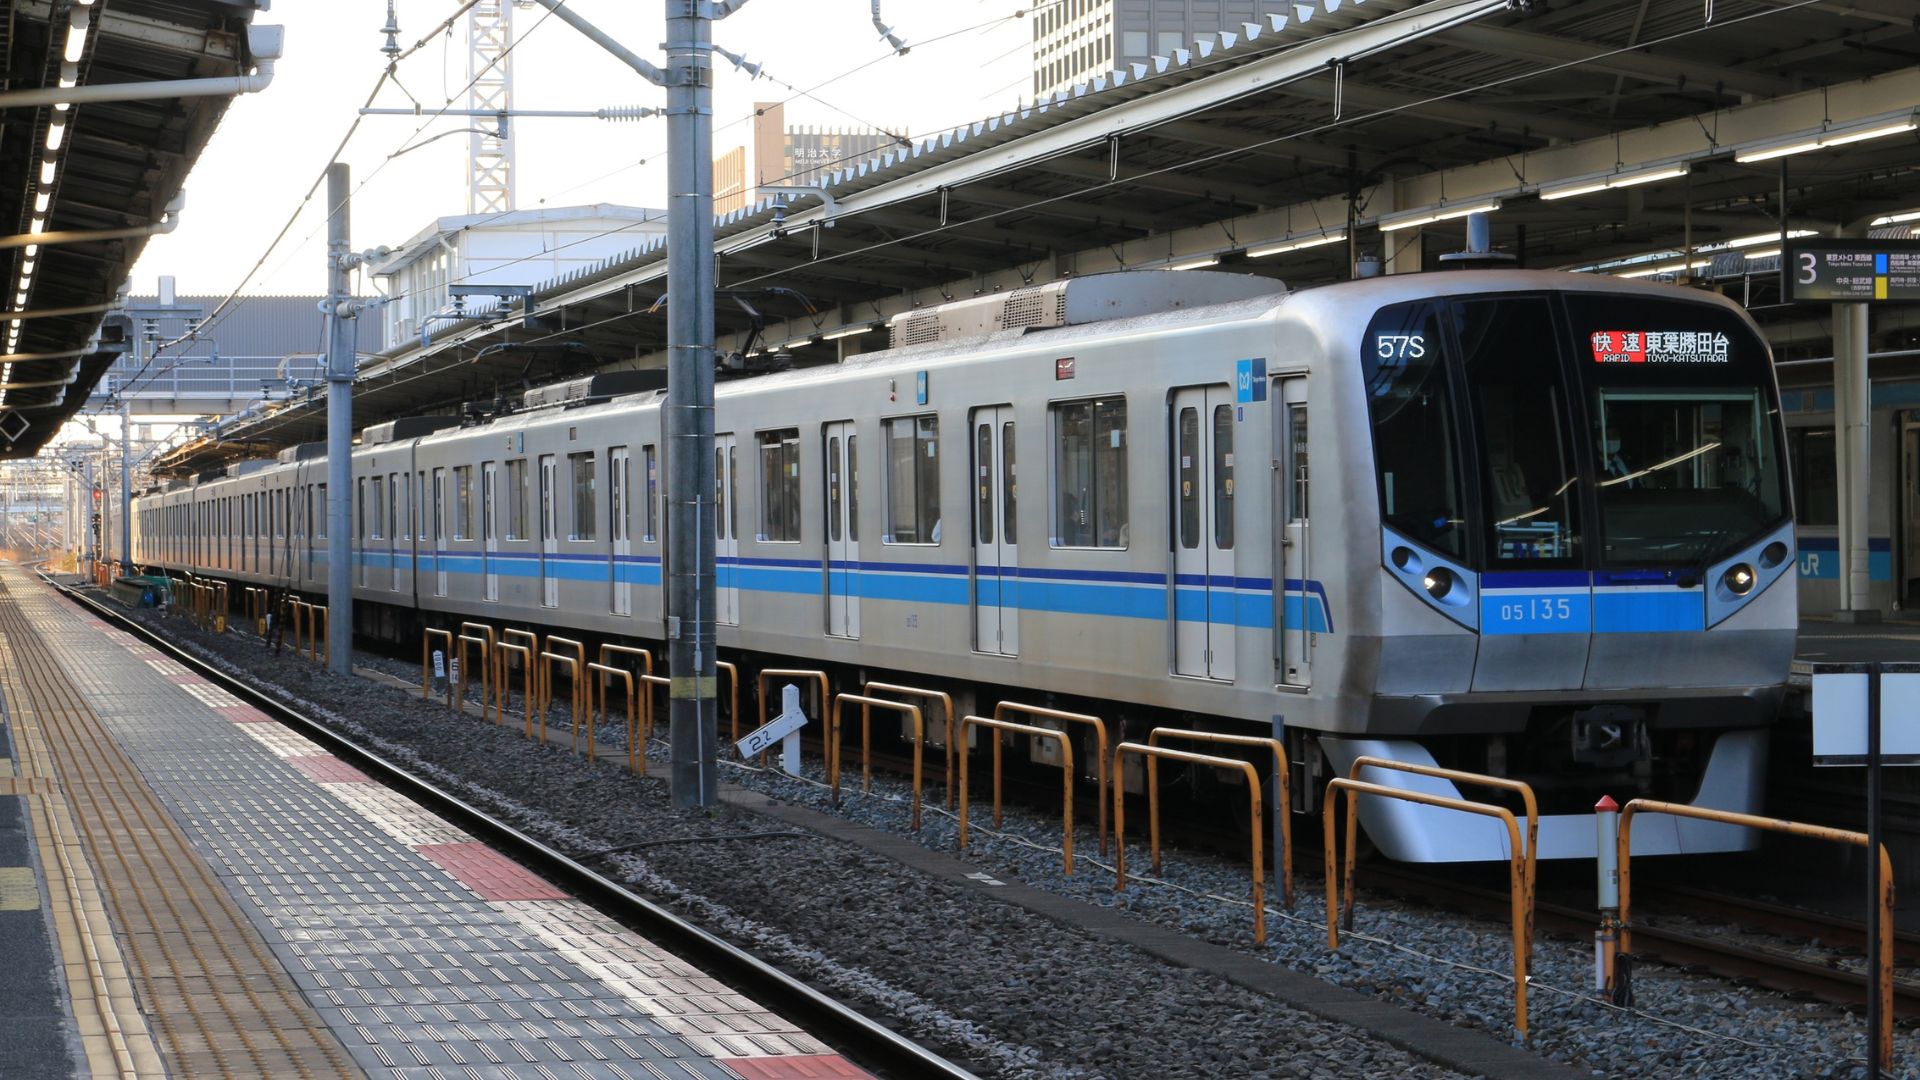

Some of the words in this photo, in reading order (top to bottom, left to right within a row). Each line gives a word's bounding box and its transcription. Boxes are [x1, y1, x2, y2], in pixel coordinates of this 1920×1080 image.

[794, 148, 841, 158] 明治大学
[1798, 253, 1817, 285] 3
[1378, 335, 1425, 358] 57S
[1645, 331, 1729, 354] 東葉勝田台
[1603, 354, 1630, 362] RAPID
[1646, 354, 1728, 362] TOYO-KATSUTADAI
[1801, 553, 1819, 576] JR
[749, 730, 772, 752] 2.2
